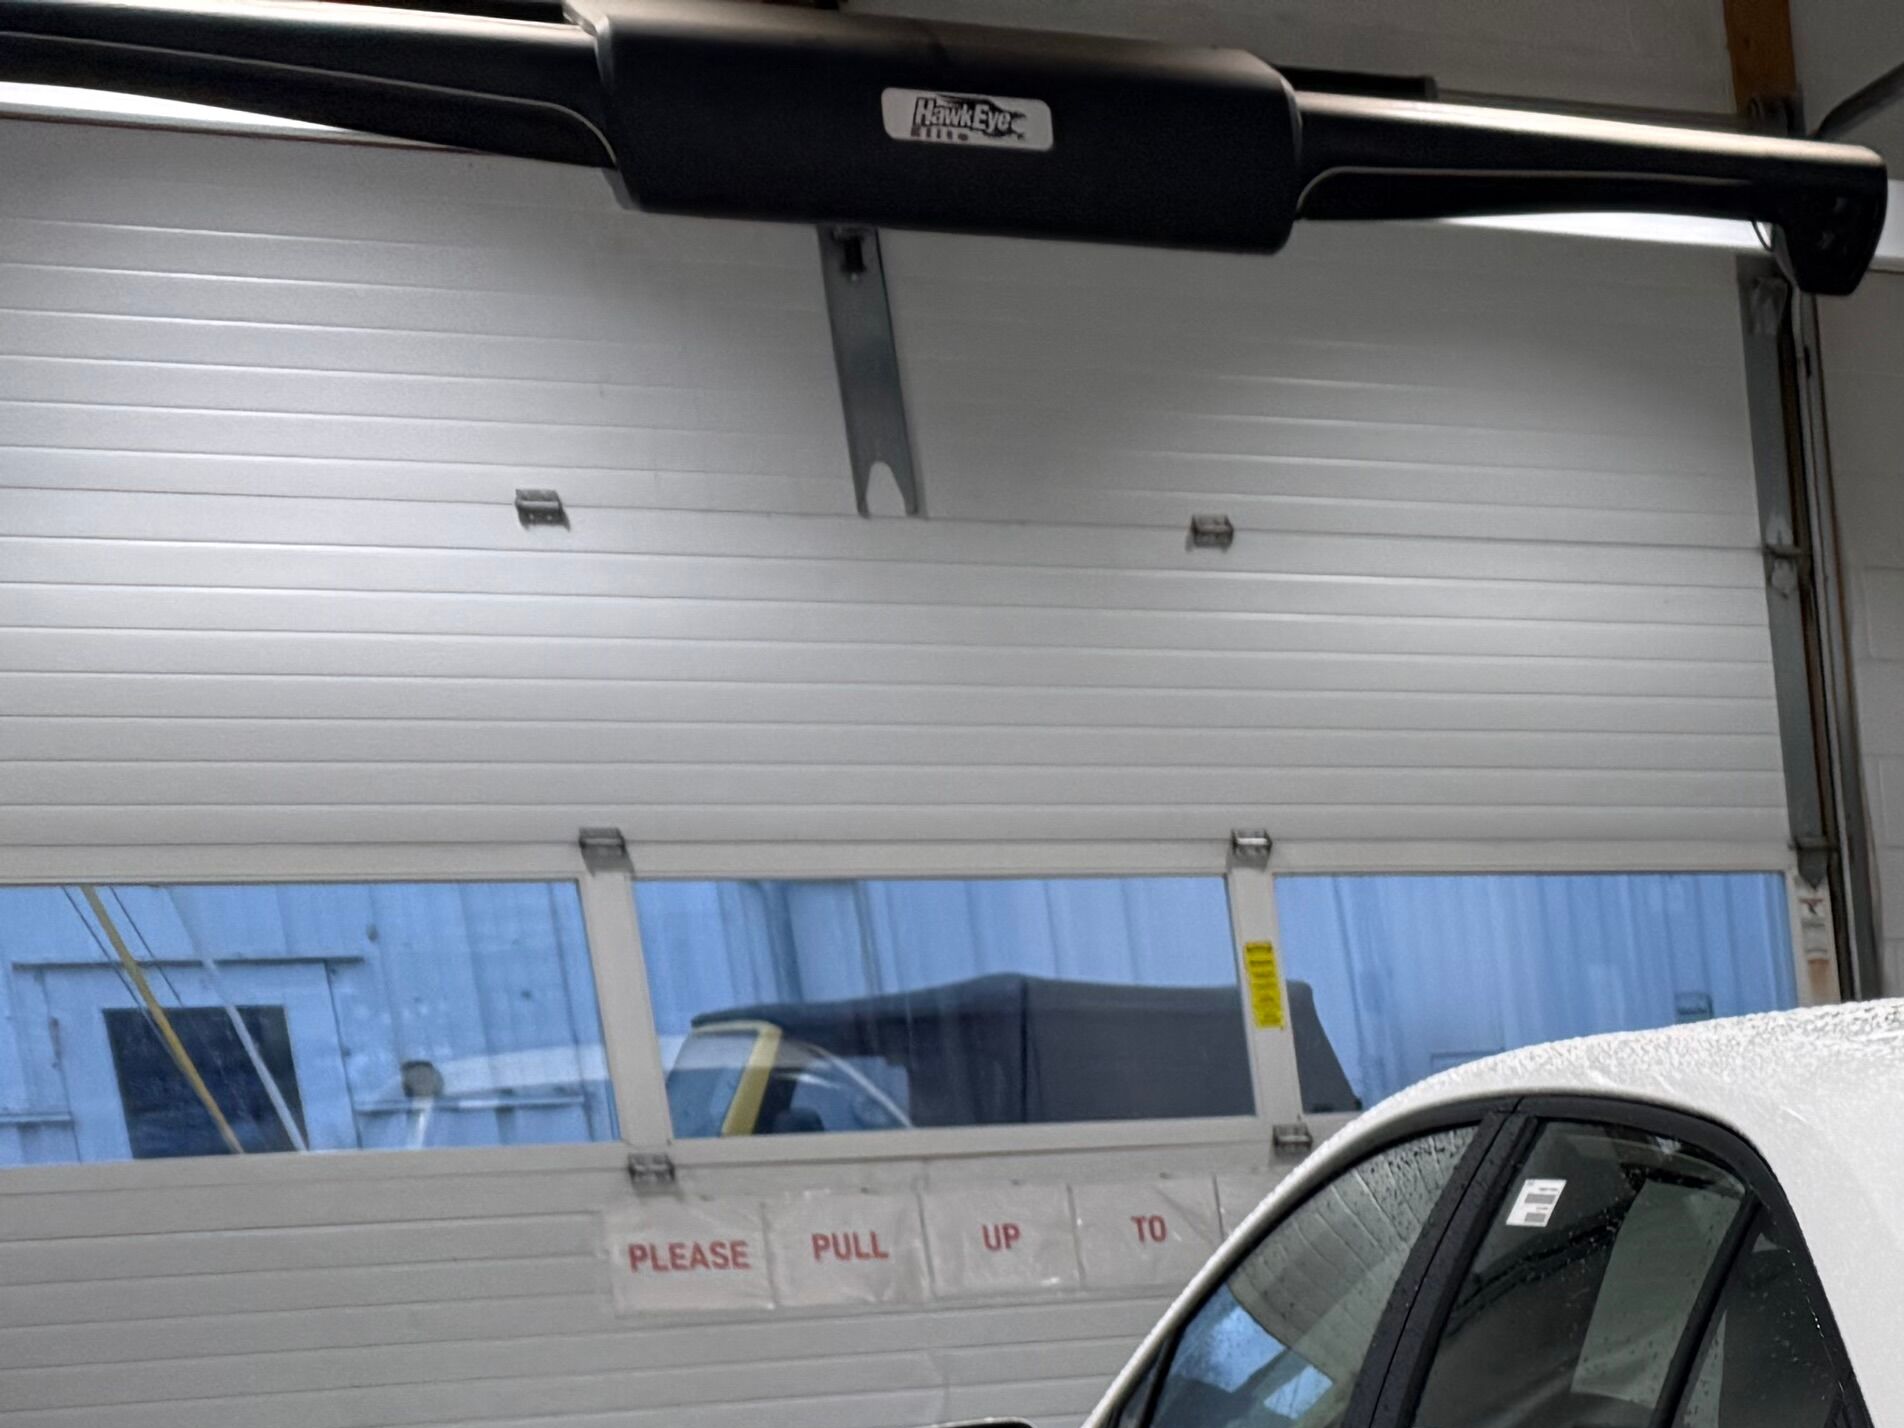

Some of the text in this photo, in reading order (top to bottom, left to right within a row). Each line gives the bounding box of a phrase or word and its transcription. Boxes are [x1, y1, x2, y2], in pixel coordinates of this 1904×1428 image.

[913, 97, 1012, 133] HawkEye
[628, 1213, 1167, 1273] PLEASE PULL UP TO
